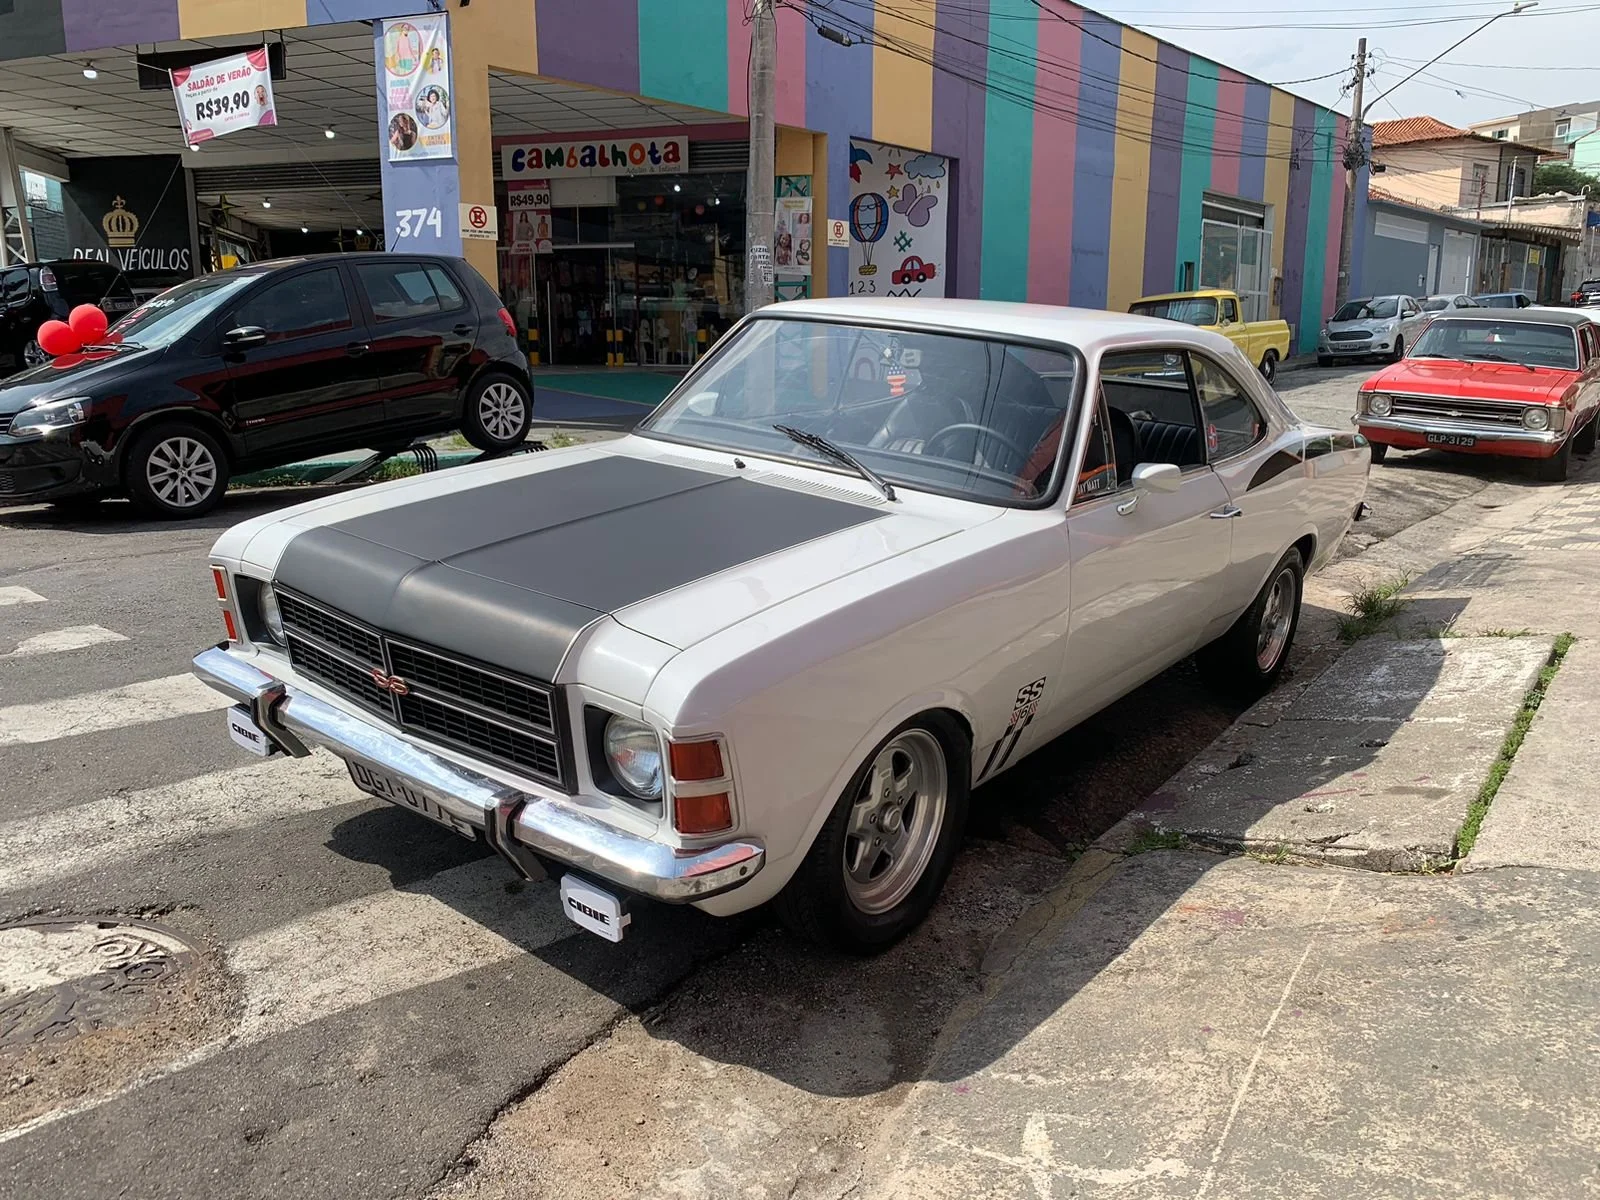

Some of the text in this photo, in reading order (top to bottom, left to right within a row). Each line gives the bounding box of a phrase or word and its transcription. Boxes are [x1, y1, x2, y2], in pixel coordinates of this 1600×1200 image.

[187, 65, 252, 92] SALDÃO DE VERÃO
[196, 90, 250, 120] R$39,90
[510, 193, 550, 207] R$49,90
[395, 207, 442, 238] 374
[118, 247, 189, 271] VEÍCULOS
[1015, 679, 1045, 708] SS
[567, 896, 610, 926] CIBIE
